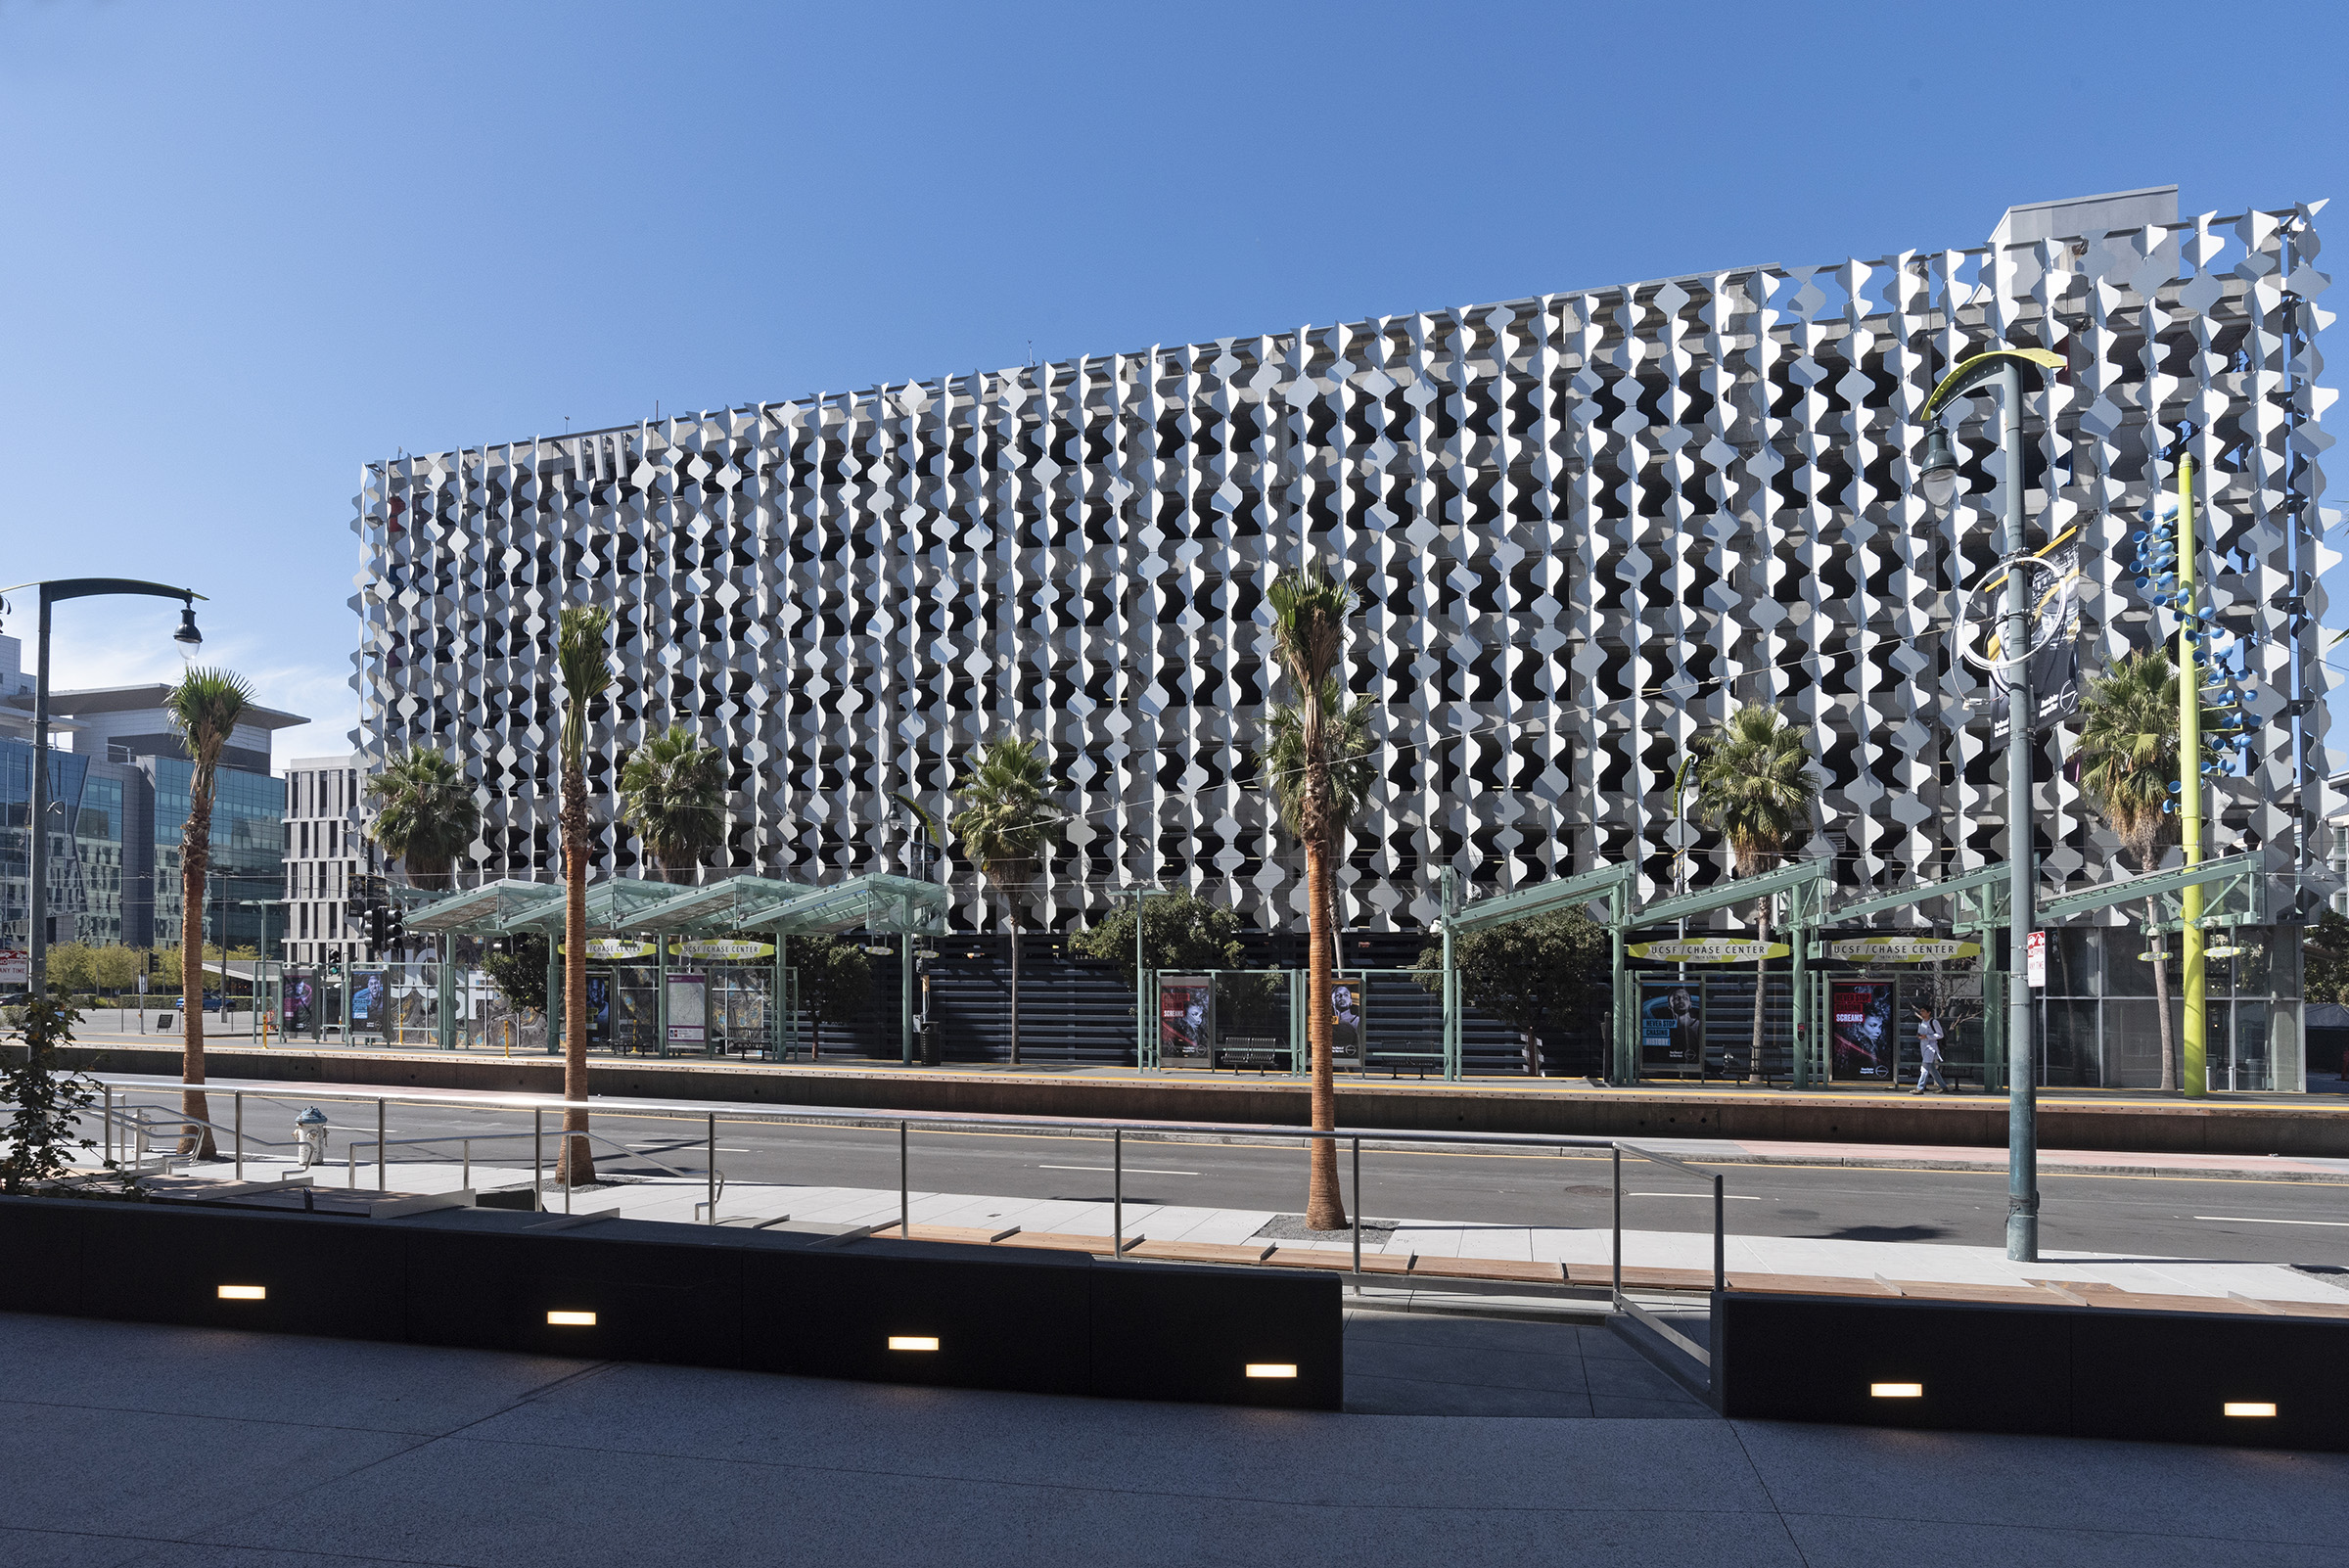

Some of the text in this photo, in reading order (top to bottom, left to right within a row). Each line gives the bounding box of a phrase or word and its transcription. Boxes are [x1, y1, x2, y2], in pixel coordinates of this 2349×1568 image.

[1651, 945, 1677, 954] UCSF
[1725, 945, 1765, 954] CENTER
[1833, 945, 1862, 954] UCSF
[1911, 945, 1955, 954] CENTER
[1836, 1013, 1864, 1022] SCREAMS
